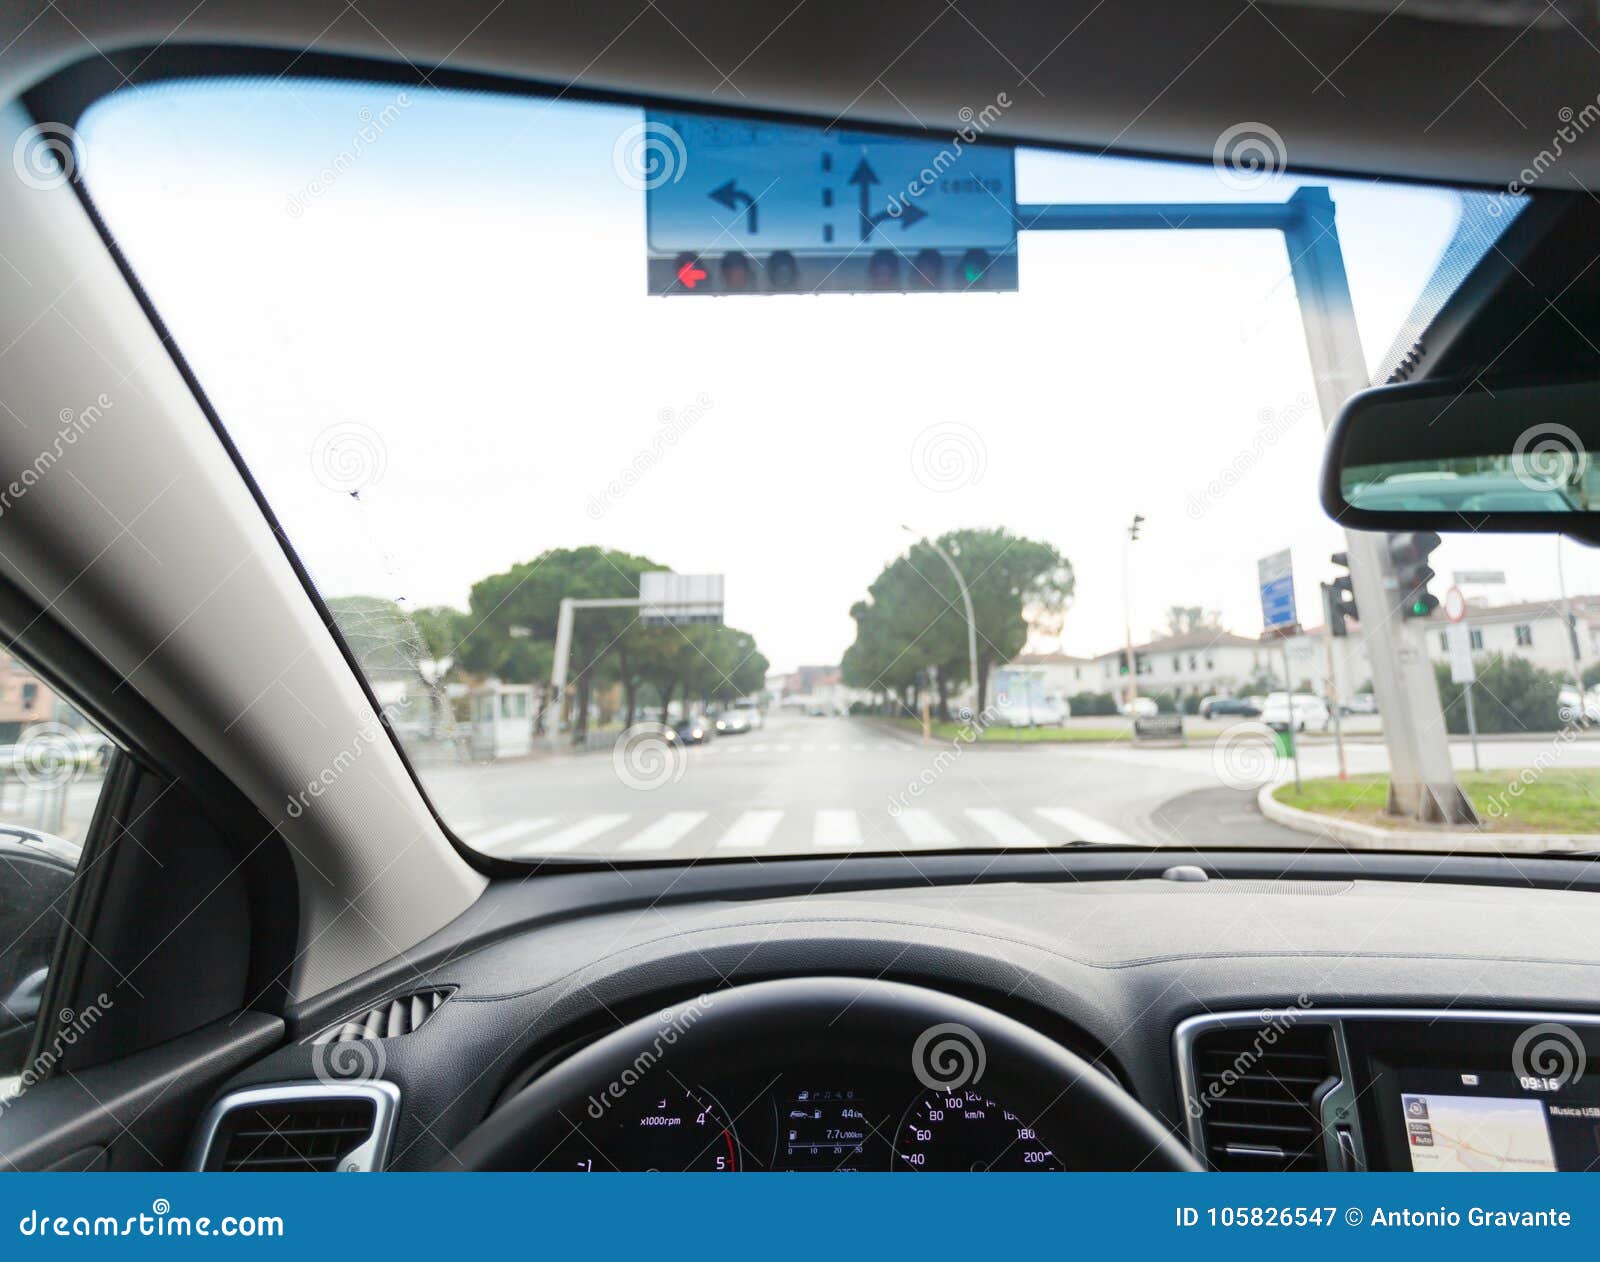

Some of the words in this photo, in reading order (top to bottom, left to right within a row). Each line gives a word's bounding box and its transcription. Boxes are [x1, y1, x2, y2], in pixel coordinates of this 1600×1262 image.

[1520, 1077, 1559, 1091] 09:16
[945, 1098, 963, 1109] 100
[929, 1110, 944, 1121] 80
[964, 1110, 985, 1120] km/h
[1549, 1105, 1581, 1117] Musica
[640, 1116, 681, 1127] x1000rpm
[696, 1112, 706, 1126] 4
[916, 1130, 932, 1141] 60
[1017, 1128, 1036, 1140] 180
[716, 1156, 726, 1170] 5
[910, 1153, 925, 1165] 40
[1024, 1151, 1044, 1163] 200
